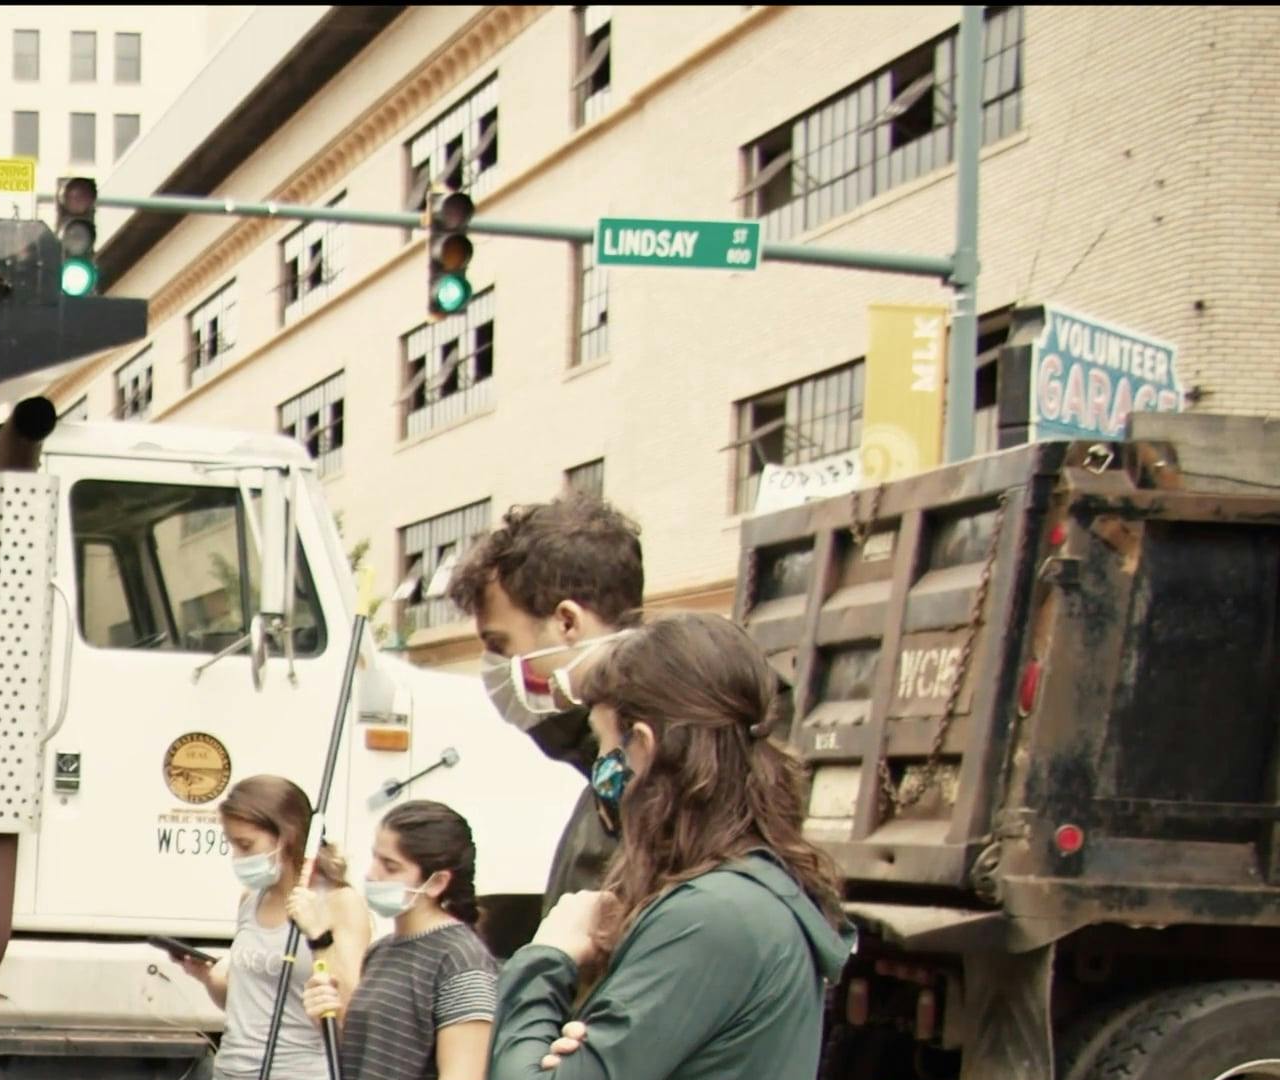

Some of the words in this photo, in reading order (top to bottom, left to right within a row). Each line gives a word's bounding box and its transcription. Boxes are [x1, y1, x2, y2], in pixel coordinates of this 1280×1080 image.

[603, 228, 700, 258] LINDSAY
[732, 228, 749, 244] ST
[911, 316, 939, 391] MLK
[1055, 316, 1168, 385] VOLUNTEER
